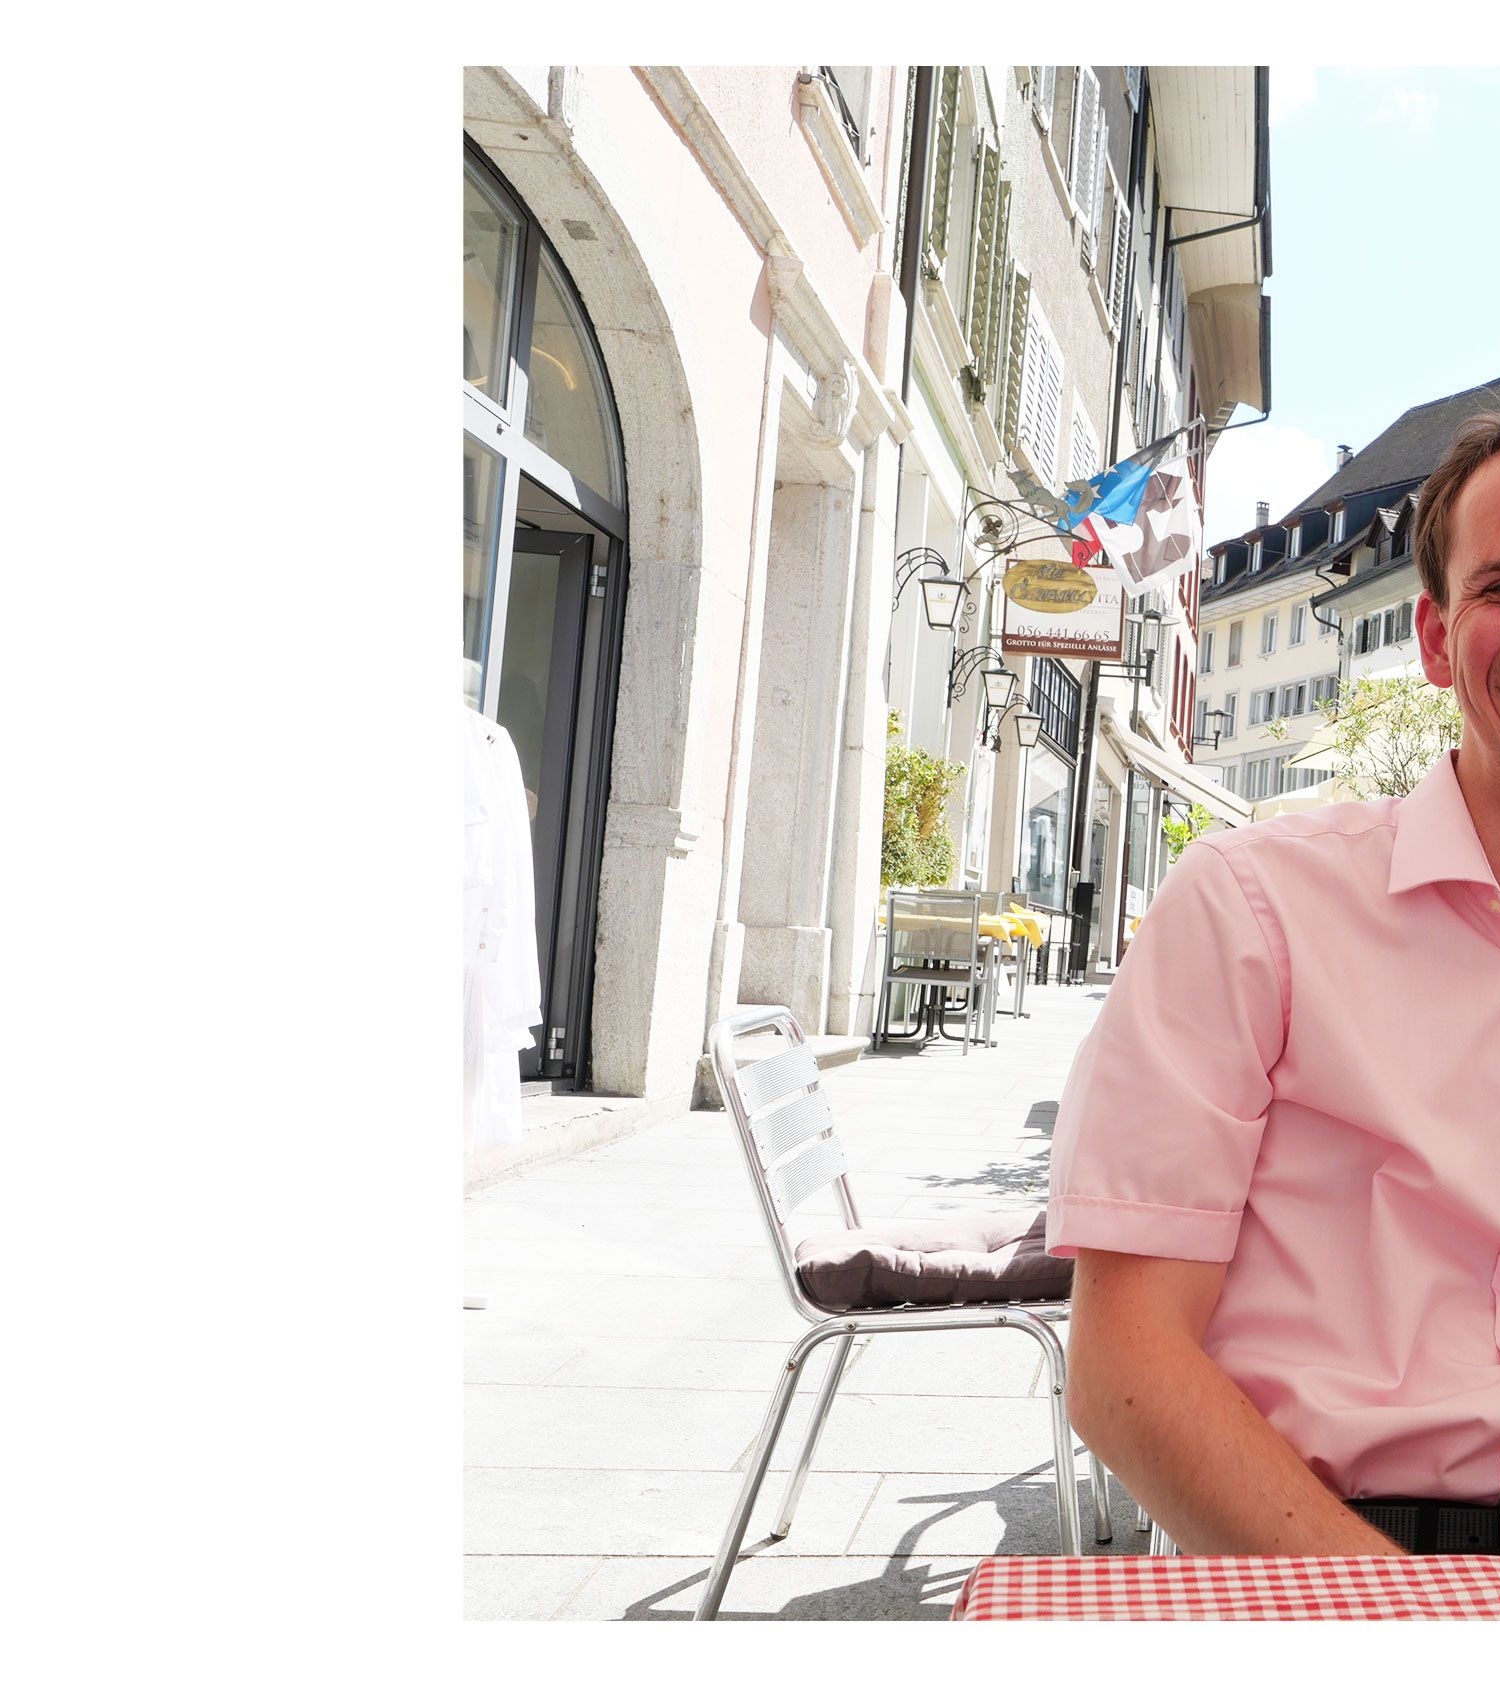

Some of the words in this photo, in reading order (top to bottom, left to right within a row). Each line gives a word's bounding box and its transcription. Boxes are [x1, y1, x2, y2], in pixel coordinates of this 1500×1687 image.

[1017, 624, 1041, 638] 056
[1046, 627, 1069, 640] 441
[1073, 628, 1090, 642] 66
[1093, 630, 1110, 643] 65
[1006, 638, 1037, 647] GROTTO
[1053, 641, 1086, 651] SPEZIELLE
